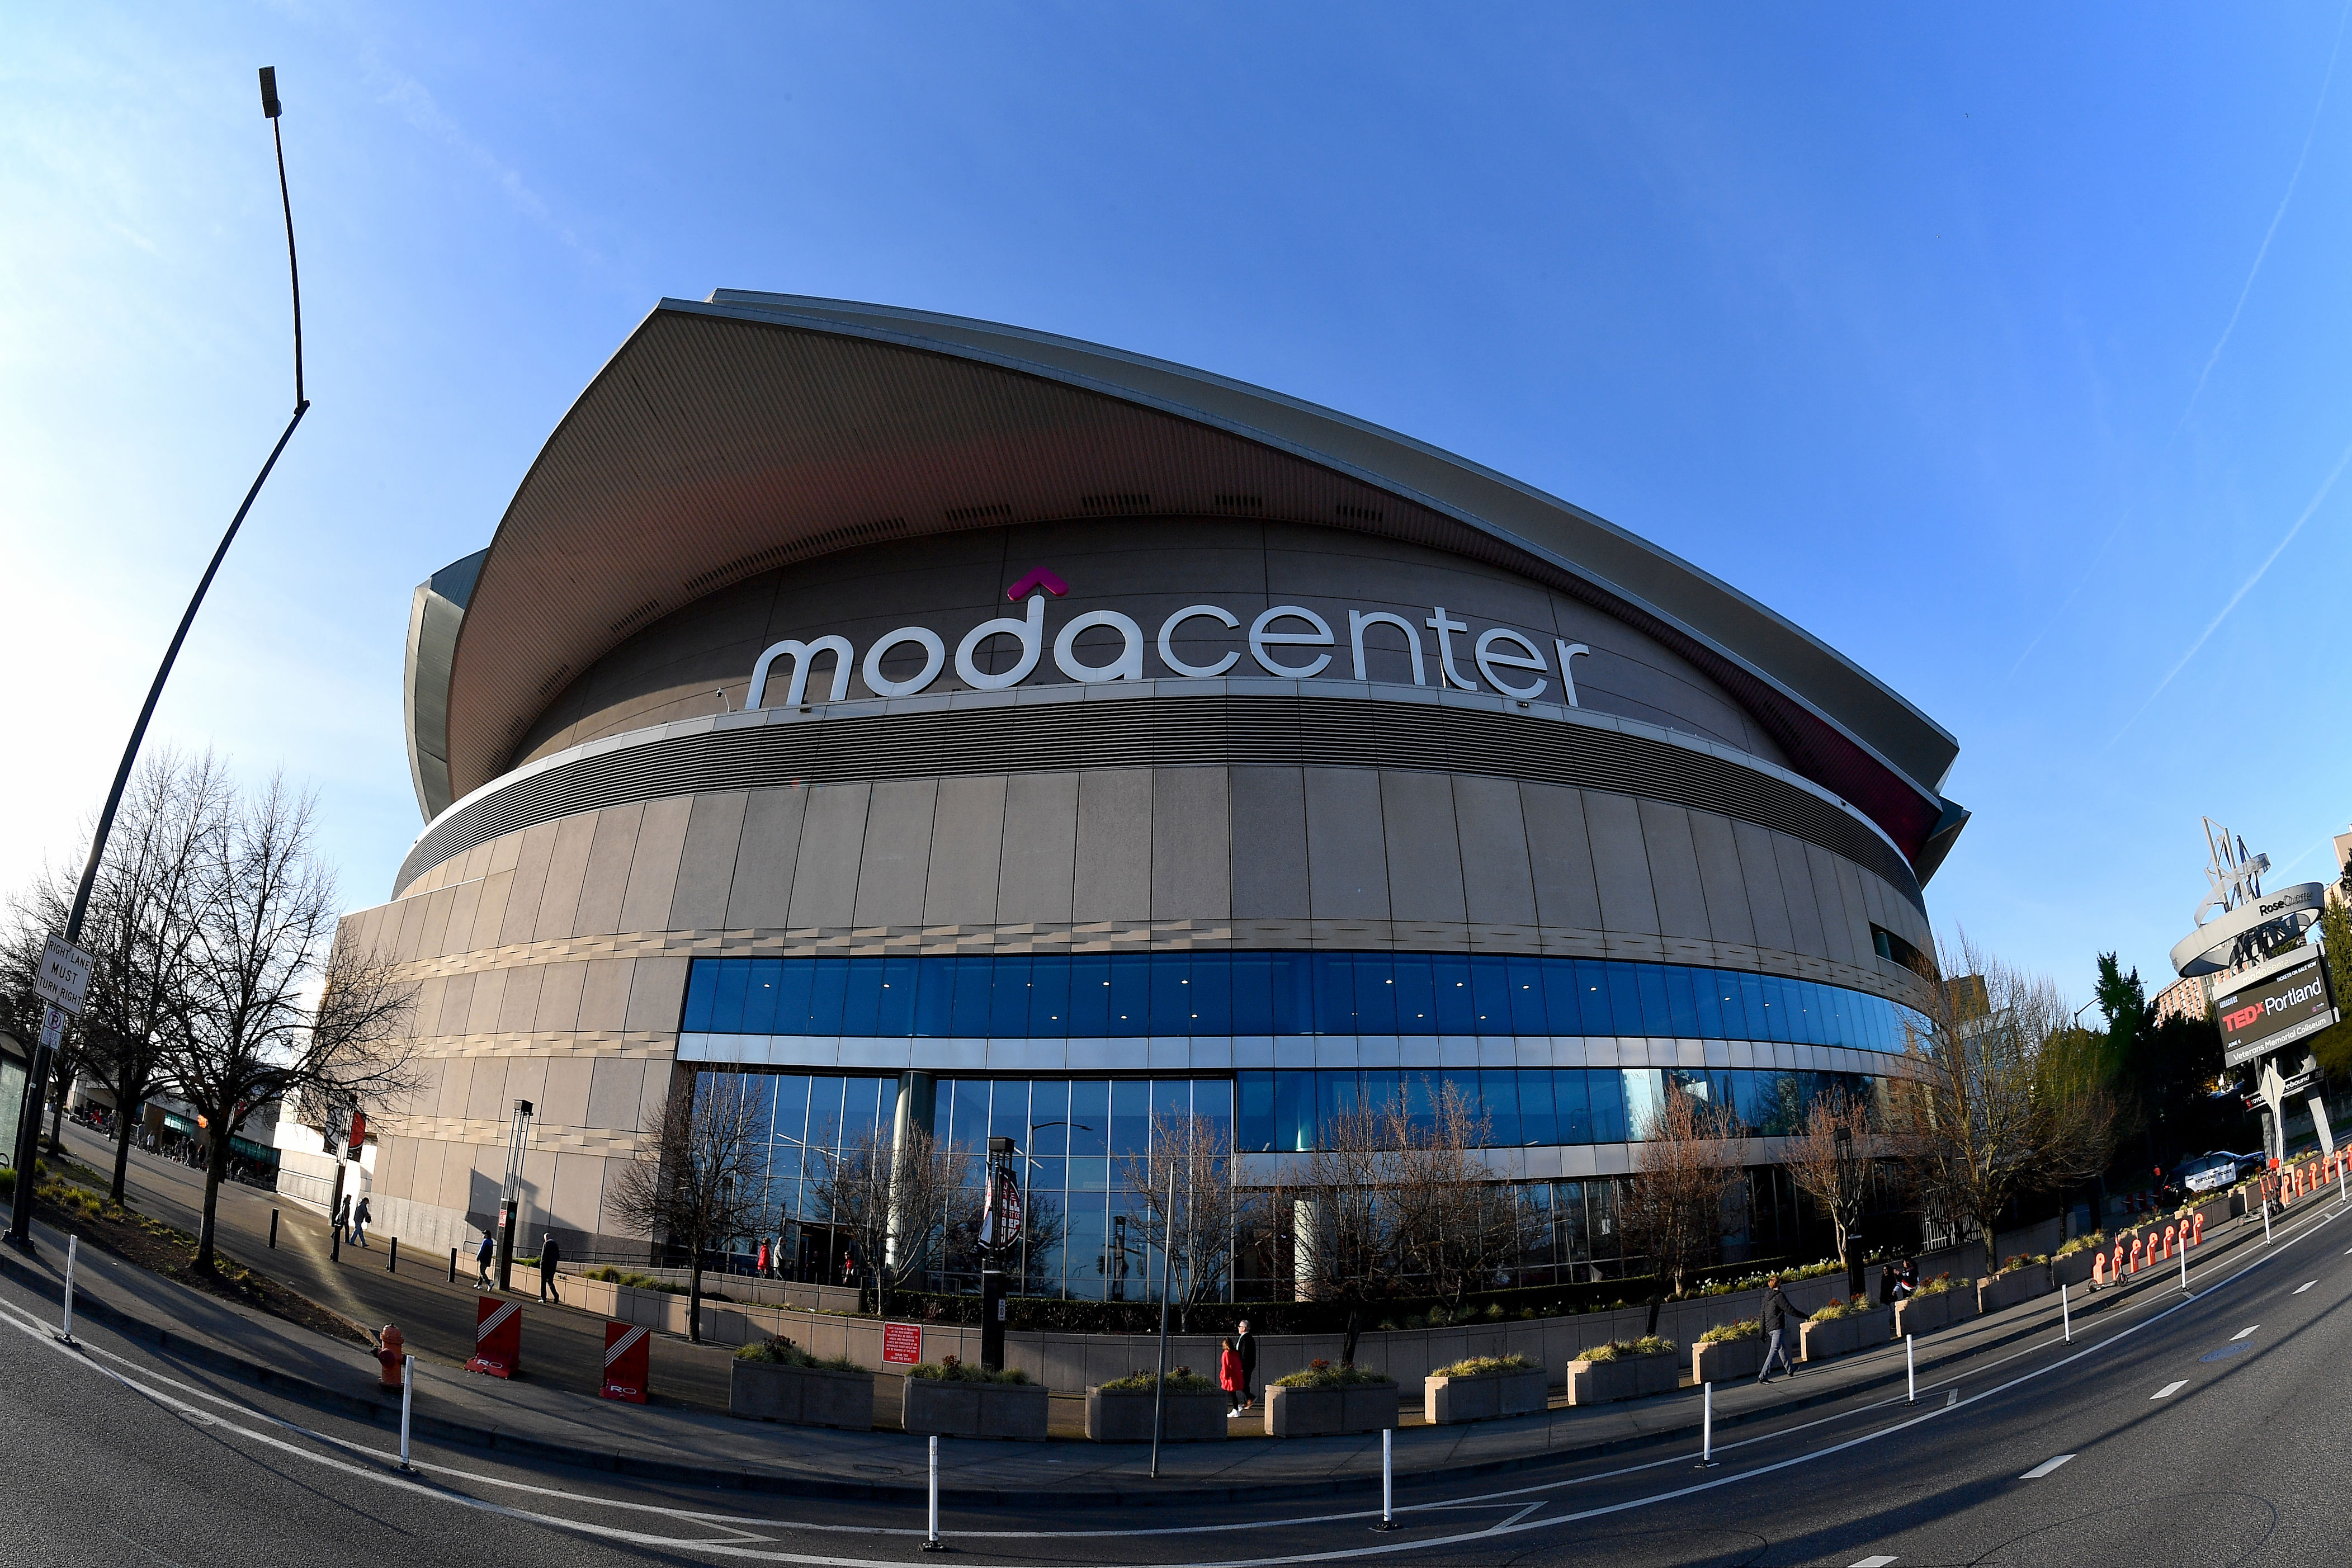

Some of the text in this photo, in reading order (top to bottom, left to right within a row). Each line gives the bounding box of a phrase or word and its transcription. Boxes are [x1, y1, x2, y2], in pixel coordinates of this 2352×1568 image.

[48, 941, 90, 970] RIGHT LANE
[51, 962, 78, 984] MUST
[2277, 972, 2292, 983] TICKETS
[39, 976, 82, 1006] TURN RIGHT
[47, 1029, 56, 1039] THIS
[2233, 1017, 2326, 1061] Veterans Memorial Coliseum
[42, 1037, 58, 1047] BLOCK
[2195, 1174, 2216, 1184] PORTLAND
[477, 1359, 503, 1368] RQ
[610, 1385, 637, 1394] RQ
